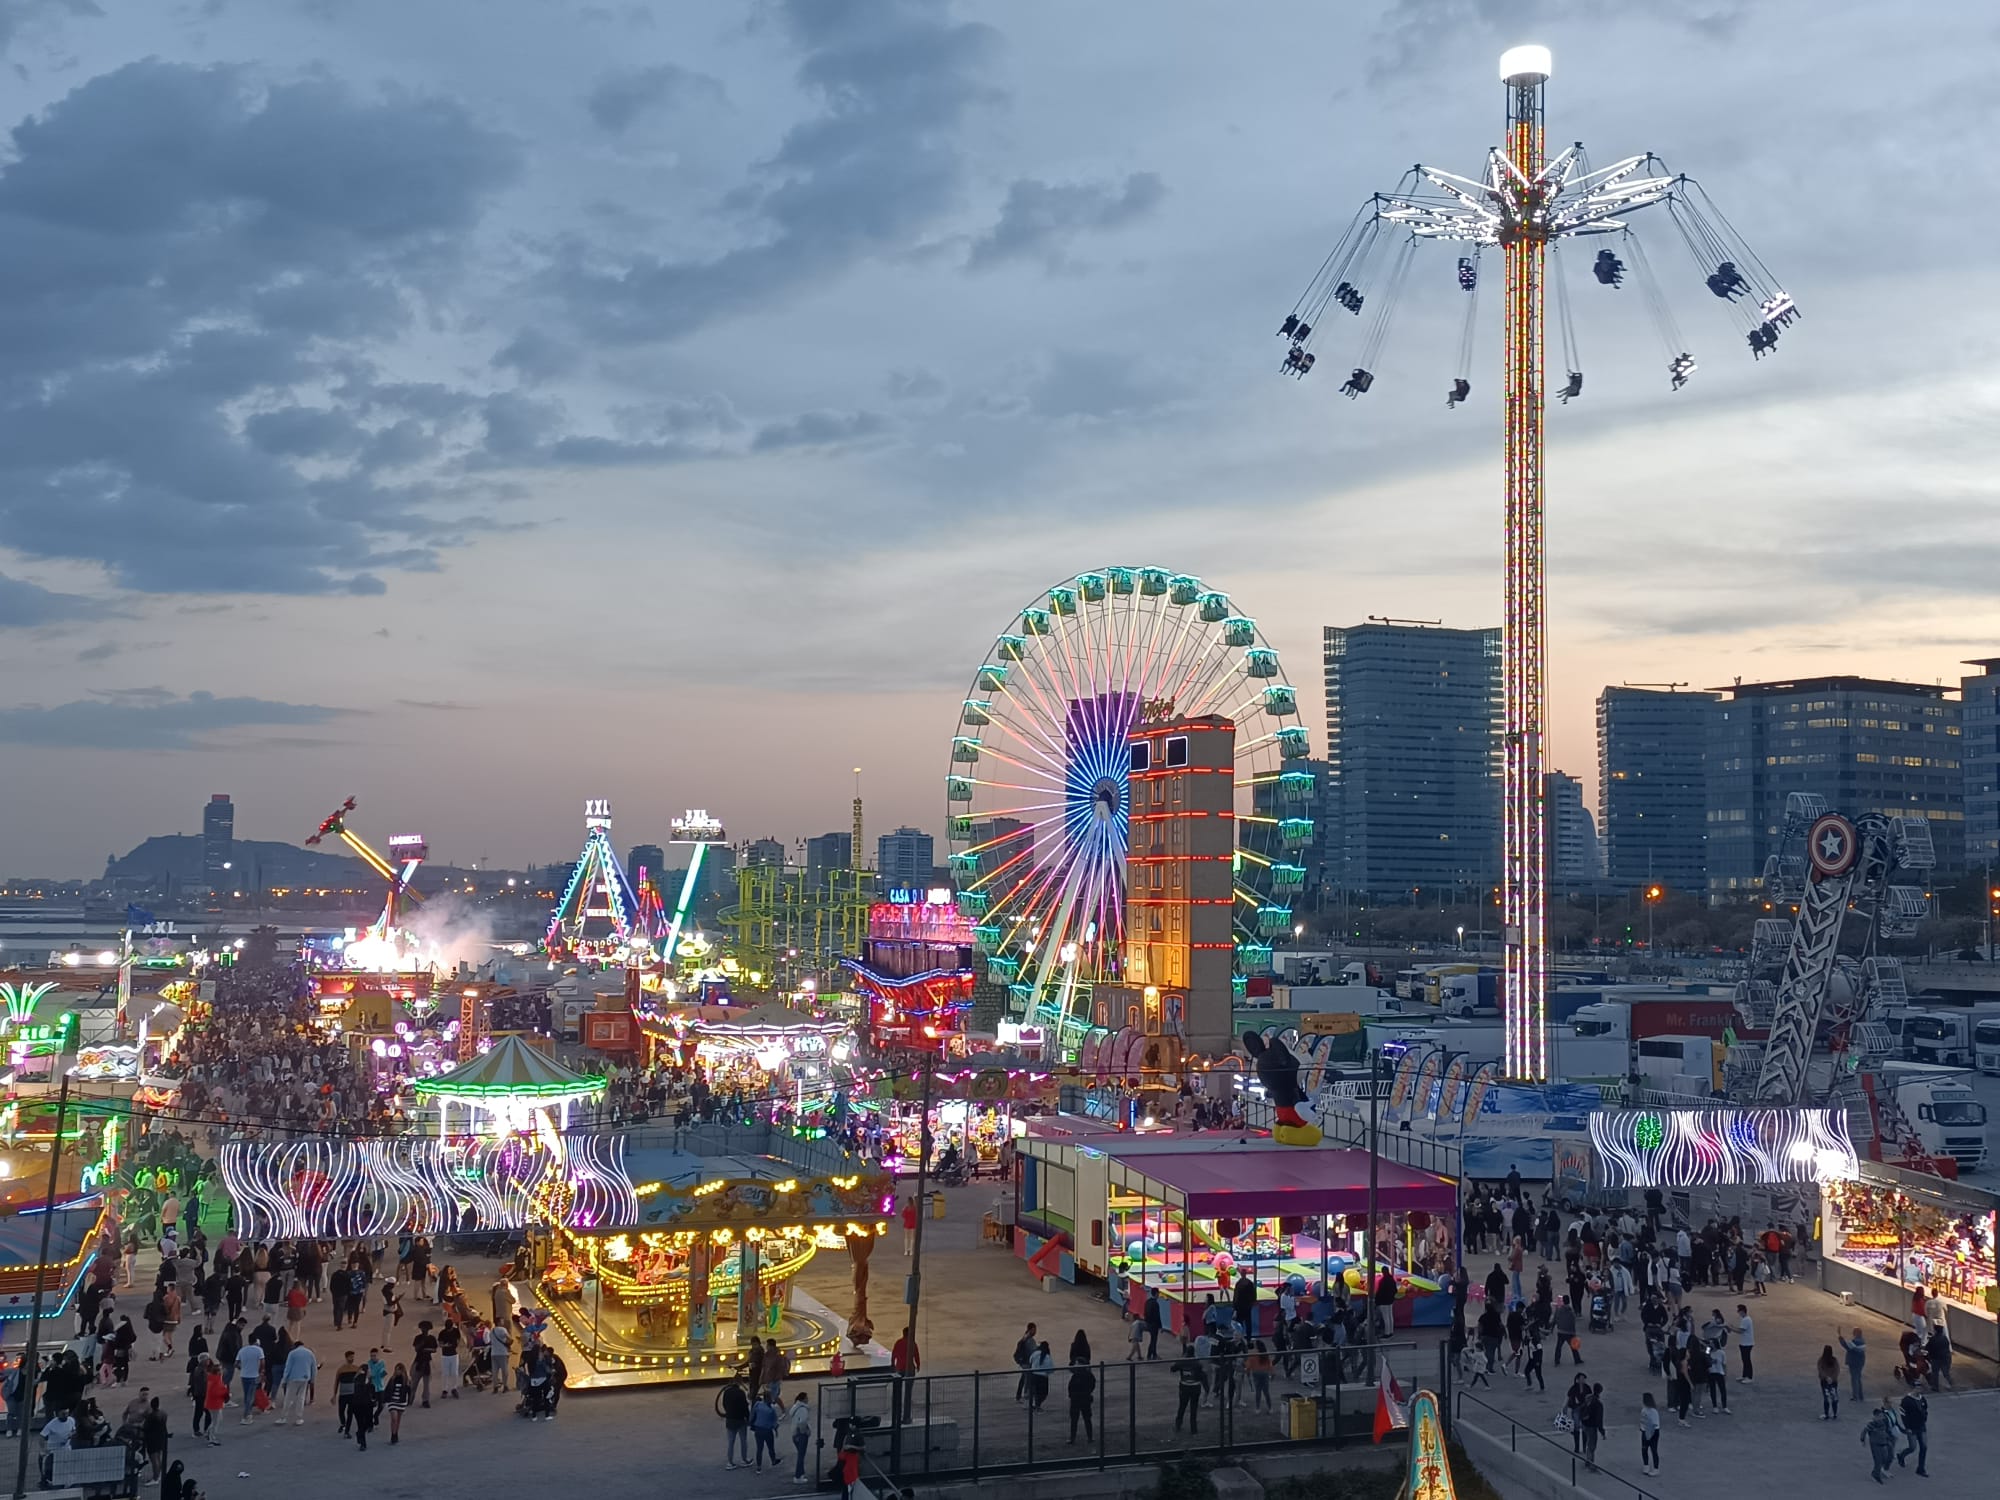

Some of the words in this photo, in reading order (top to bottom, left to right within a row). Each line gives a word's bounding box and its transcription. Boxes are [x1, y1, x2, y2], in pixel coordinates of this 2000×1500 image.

[584, 799, 610, 816] XXL
[889, 888, 910, 904] CASA
[912, 888, 924, 904] DL
